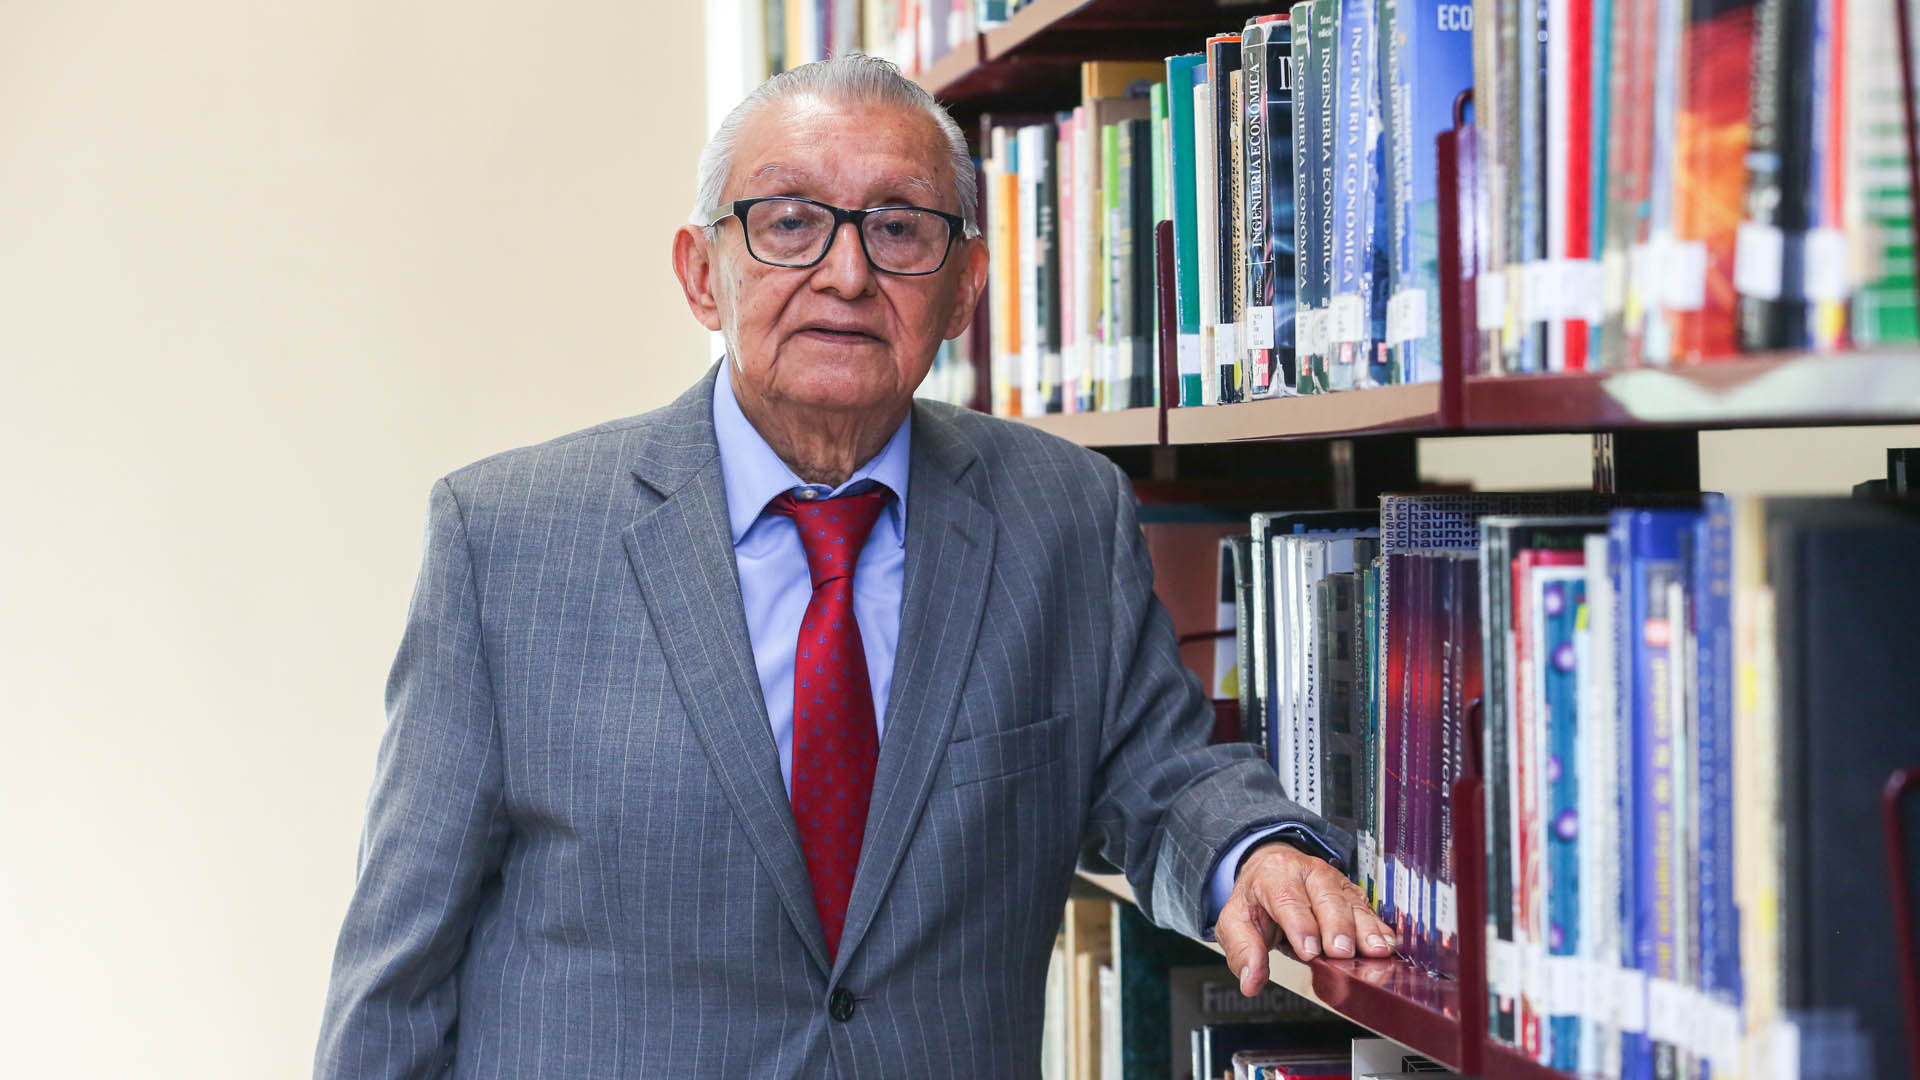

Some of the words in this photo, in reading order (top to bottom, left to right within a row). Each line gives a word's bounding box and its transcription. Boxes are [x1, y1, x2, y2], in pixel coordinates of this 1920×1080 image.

[1249, 64, 1261, 156] ECONÓMICA
[1297, 55, 1307, 167] INGENIERÍA
[1348, 26, 1362, 146] INGENIERÍA
[1250, 159, 1263, 248] INGENIERÍA
[1298, 173, 1308, 289] ECONÓMICA
[1343, 152, 1357, 284] ECONÓMICA
